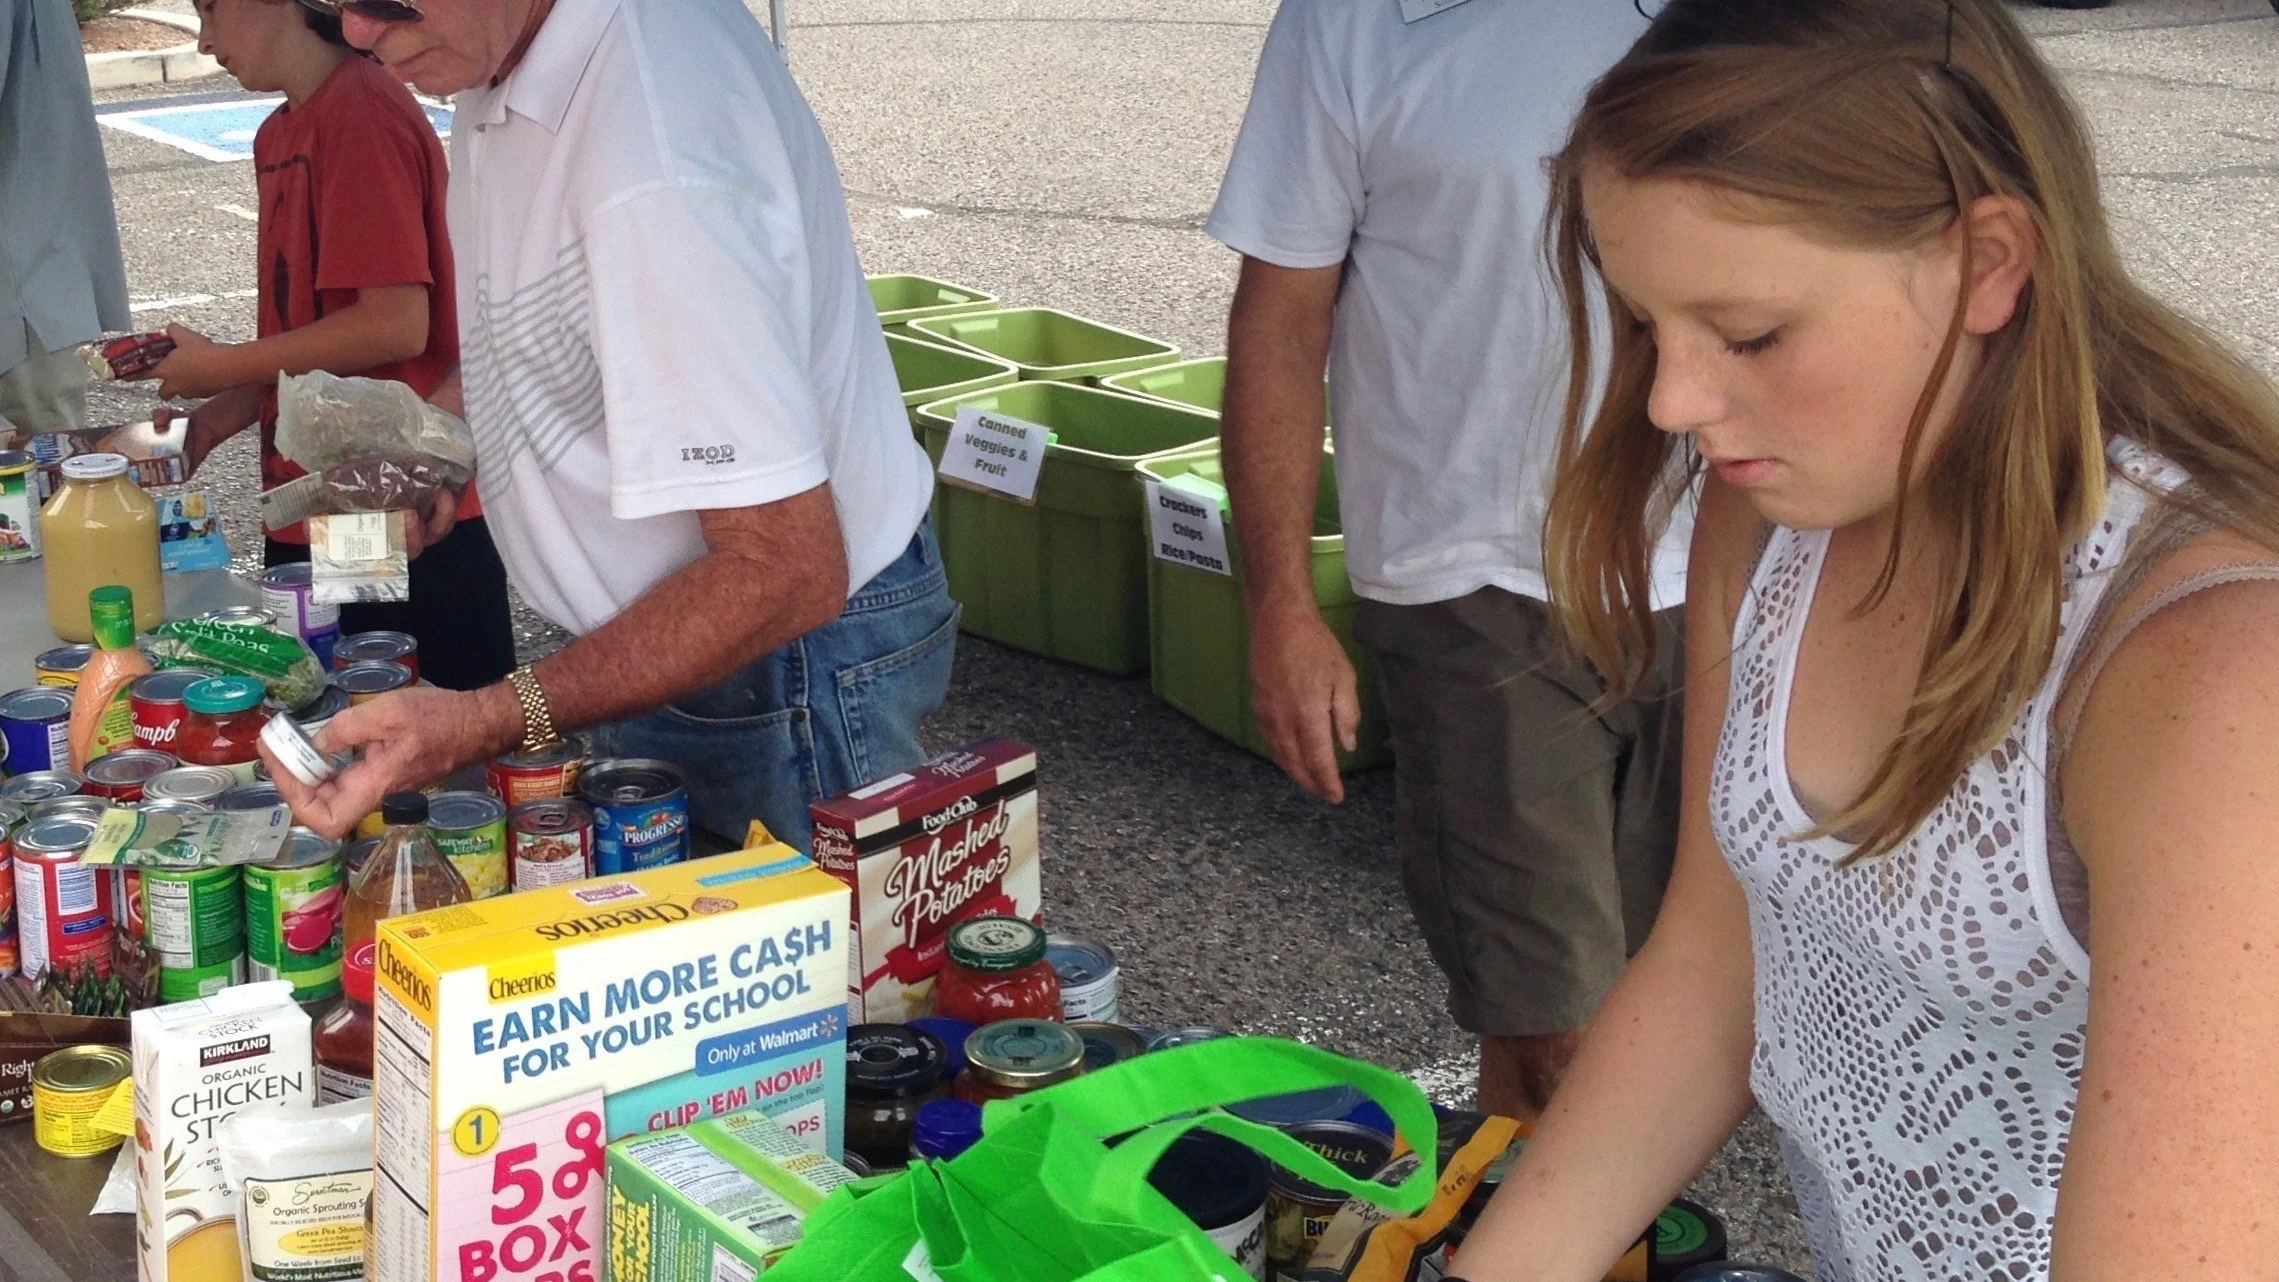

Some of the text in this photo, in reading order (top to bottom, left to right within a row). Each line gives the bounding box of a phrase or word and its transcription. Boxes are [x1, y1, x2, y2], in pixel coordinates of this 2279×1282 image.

[978, 416, 1027, 439] Canned
[681, 444, 735, 461] IZOD
[965, 433, 1028, 462] Veggies &
[974, 458, 1007, 477] Fruit
[1160, 495, 1207, 519] Crackers
[1172, 522, 1204, 541] Chips
[1161, 543, 1223, 570] Rice/Pasta
[813, 838, 854, 857] Mashed
[816, 851, 856, 871] Potatoes
[885, 799, 1007, 901] Mashed
[894, 848, 1009, 949] Potatoes
[535, 902, 690, 942] Cheerios
[378, 939, 431, 1012] Cheerios
[472, 920, 832, 1055] EARN MORE CA$H
[489, 970, 556, 1000] Cheerios
[503, 969, 811, 1084] FOR YOUR SCHOOL
[203, 1037, 269, 1059] KIRKLAND
[708, 1023, 818, 1064] Only at Walmart
[1, 1059, 35, 1083] Righ
[202, 1063, 267, 1085] ORGANIC
[171, 1071, 302, 1118] CHICKEN
[647, 1058, 823, 1132] CLIP 'EM NOW!
[469, 1114, 482, 1146] 1
[1306, 1140, 1369, 1164] Thick
[491, 1142, 544, 1225] 5
[273, 1201, 356, 1217] Organic Sprouting
[626, 1201, 638, 1248] YOUR
[458, 1206, 591, 1282] BOX
